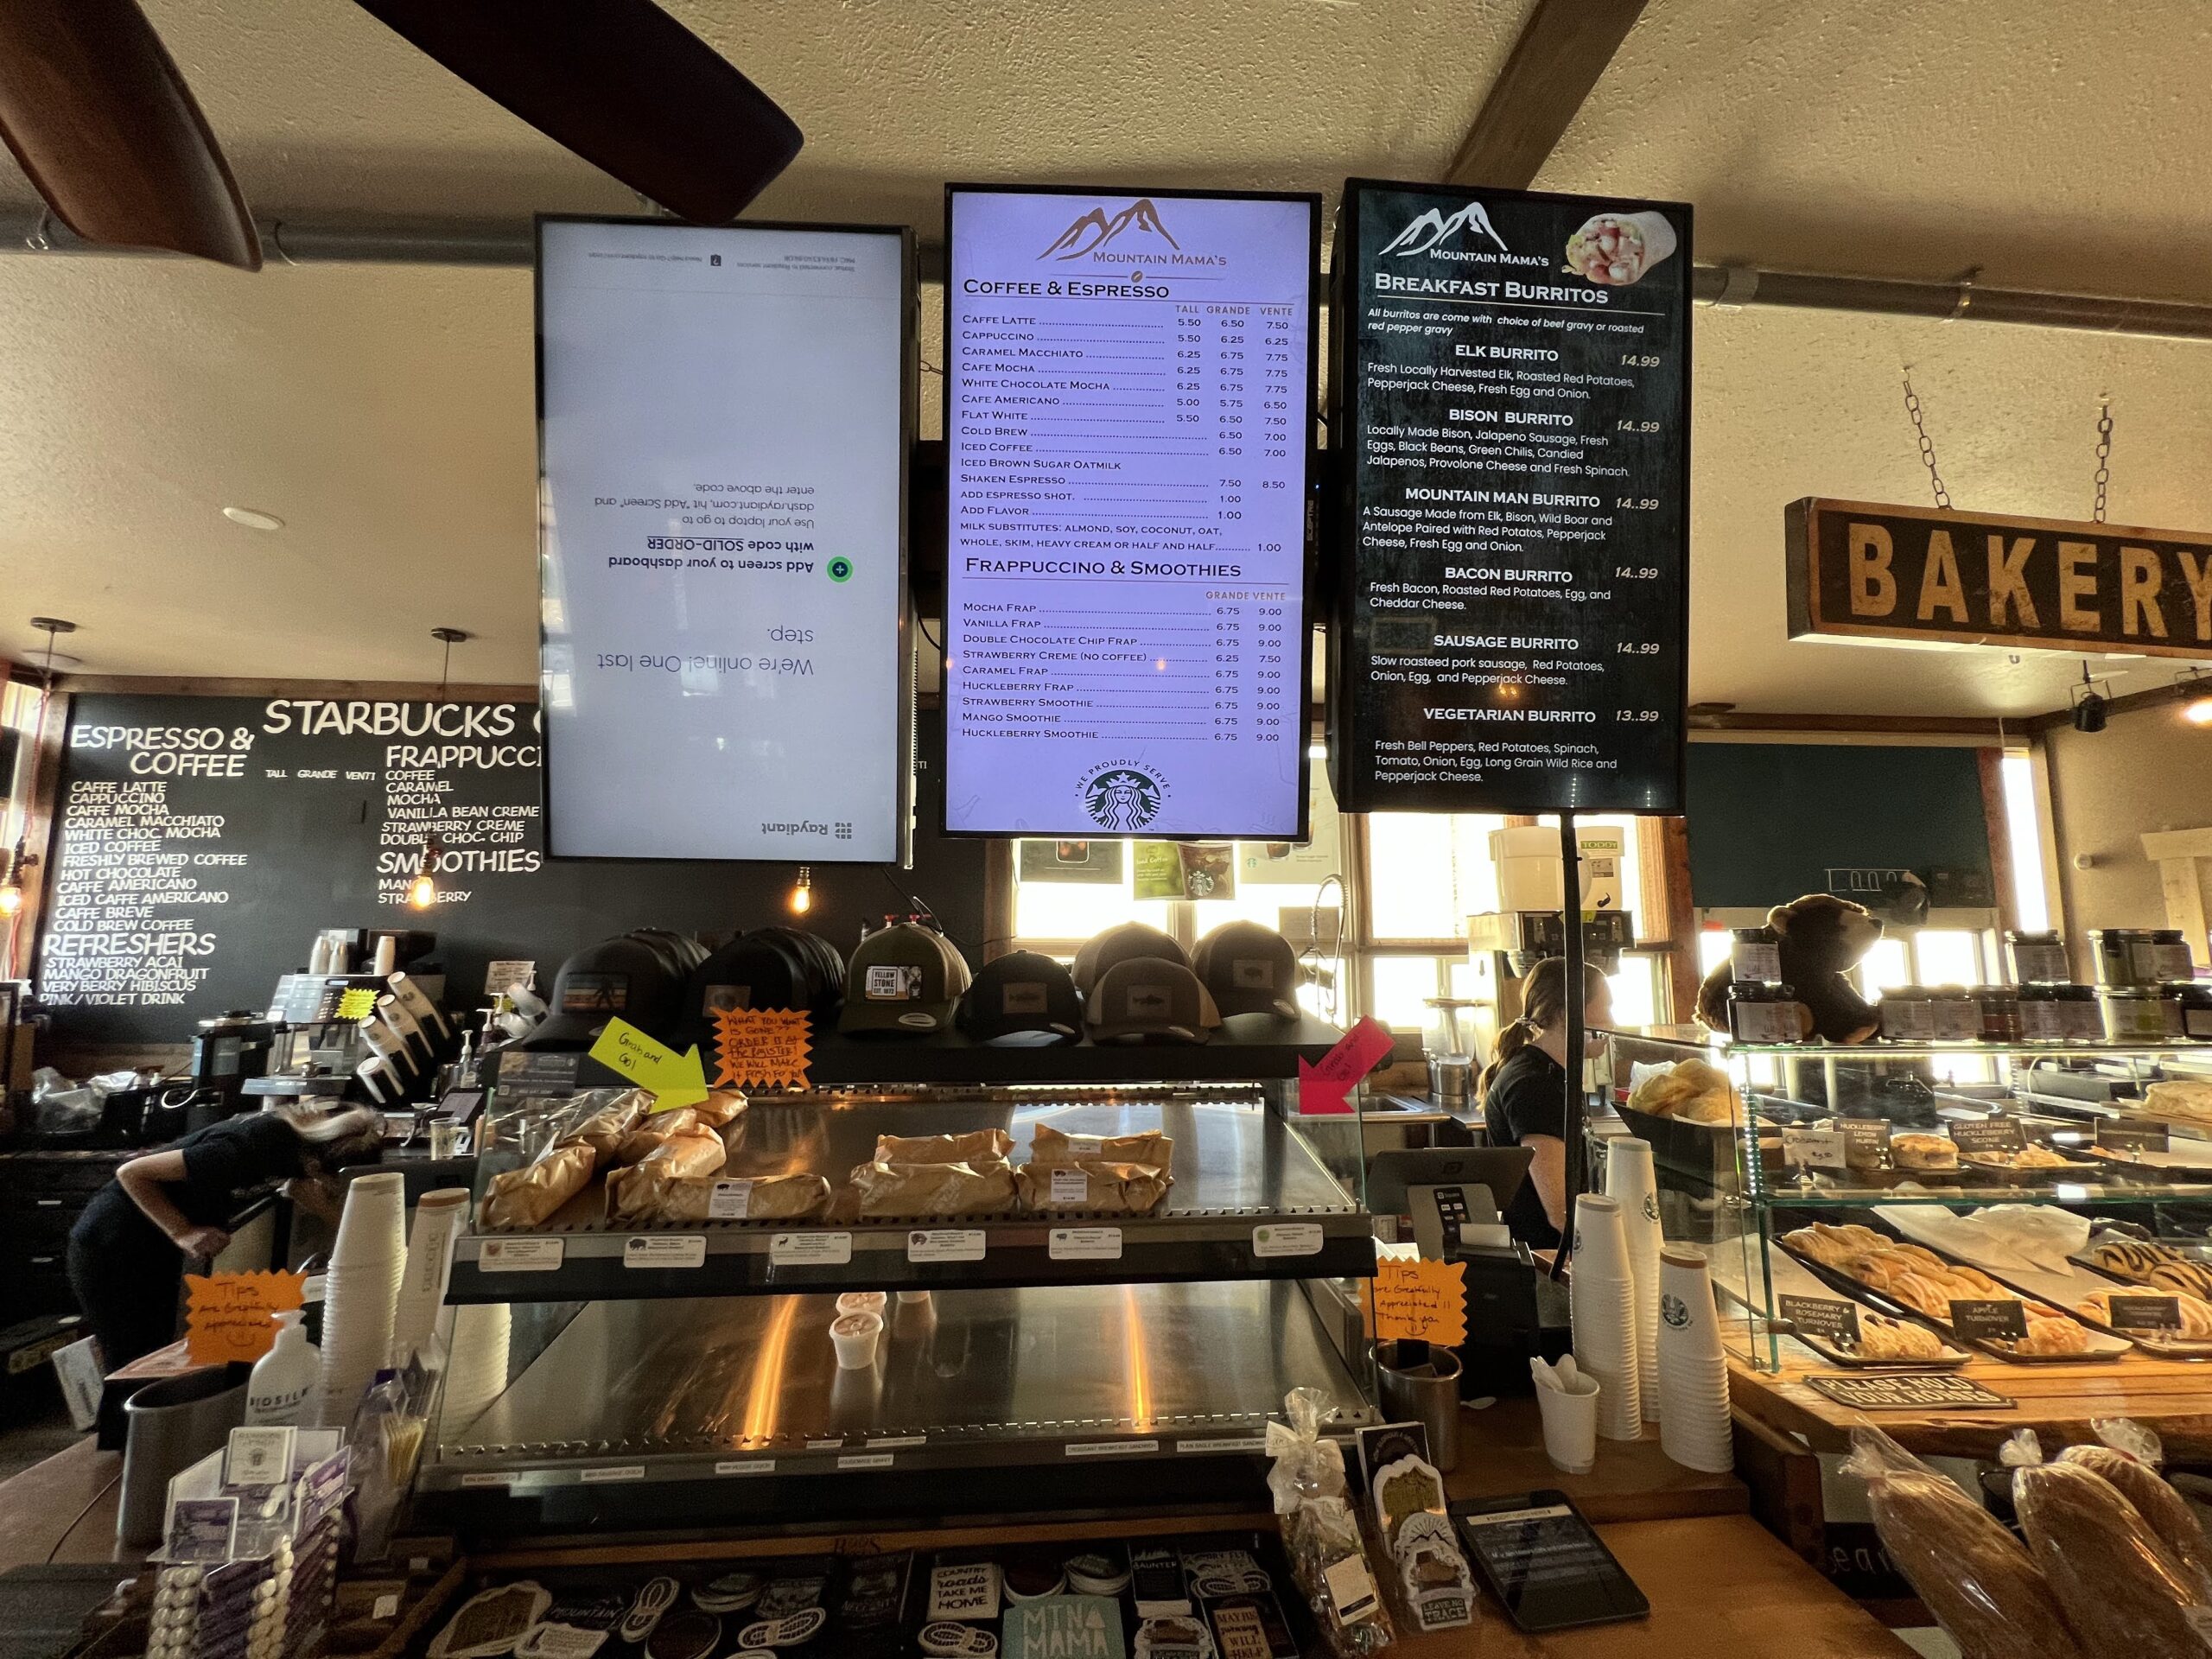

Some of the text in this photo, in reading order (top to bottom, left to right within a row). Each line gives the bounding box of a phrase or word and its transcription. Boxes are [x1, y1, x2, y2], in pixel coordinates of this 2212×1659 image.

[1094, 252, 1226, 265] MOUNTAIN MAMA'S
[1430, 249, 1548, 266] MOUNTAIN MAMA'S
[964, 279, 1168, 299] COFFEE & ESPRESSO
[1376, 273, 1608, 303] BREAKFAST BURRITOS
[1207, 306, 1249, 315] GRANDE
[1383, 308, 1420, 319] burritos
[1472, 315, 1491, 323] with
[1497, 316, 1529, 326] choice
[1532, 318, 1541, 327] of
[1543, 319, 1565, 327] beef
[1567, 322, 1594, 332] gravy
[1368, 321, 1452, 336] red pepper gravy
[963, 331, 1033, 340] CAPPUCCINO
[1456, 345, 1660, 367] ELK BURRITO 14.99
[1369, 363, 1634, 387] Fresh Locally Harvested Elk, Roasted Red Potatoes,
[1450, 410, 1497, 422] BISON
[1505, 412, 1573, 426] BURRITO
[648, 537, 814, 552] with code SOLID-ORDER
[609, 557, 683, 569] dashboard
[687, 557, 716, 567] your
[721, 560, 734, 569] to
[787, 562, 813, 573] Add
[967, 558, 1241, 576] FRAPPUCCINO & SMOOTHIES
[1849, 523, 2212, 640] BAKERY
[1206, 591, 1249, 600] GRANDE
[767, 626, 813, 644] step.
[1434, 635, 1507, 647] SAUSAGE
[1511, 638, 1579, 650] BURRITO
[598, 654, 813, 675] We're online! One last
[263, 700, 515, 737] STARBUCKS
[1424, 709, 1523, 721] VEGETARIAN
[1529, 710, 1595, 722] BURRITO
[71, 722, 255, 750] ESPRESSO &
[963, 728, 1040, 737] HUCKLEBERRY
[130, 752, 247, 777] COFFEE
[297, 770, 338, 779] GRANDE
[346, 772, 375, 780] VENTI
[385, 770, 435, 780] COFFEE
[1076, 759, 1171, 791] WE PROUDLY SERVE
[72, 781, 167, 793] CAFFE LATTE
[386, 781, 454, 792] CARAMEL
[69, 793, 165, 804] CAPPUCCINO
[65, 816, 225, 829] CARAMEL MACCHIATO
[762, 821, 828, 836] Raydiant
[42, 932, 217, 956] REFRESHERS
[43, 968, 211, 981] MANGO DRAGONFRUIT
[762, 1017, 779, 1026] YOU
[644, 1052, 663, 1065] and
[729, 1059, 745, 1069] WE
[1785, 1300, 1840, 1313] BLACKBERRY
[1796, 1310, 1842, 1320] ROSEMARY
[1796, 1318, 1843, 1329] TURNOVER
[1821, 1377, 1974, 1390] PLEASE HOLD
[1839, 1390, 2001, 1403] YOUR HORSES
[937, 1567, 987, 1578] COUNTRY
[938, 1575, 986, 1588] roads
[938, 1588, 965, 1597] TAKE
[938, 1597, 988, 1610] HOME
[1425, 1607, 1465, 1620] TRACE
[1023, 1629, 1109, 1657] MAMA
